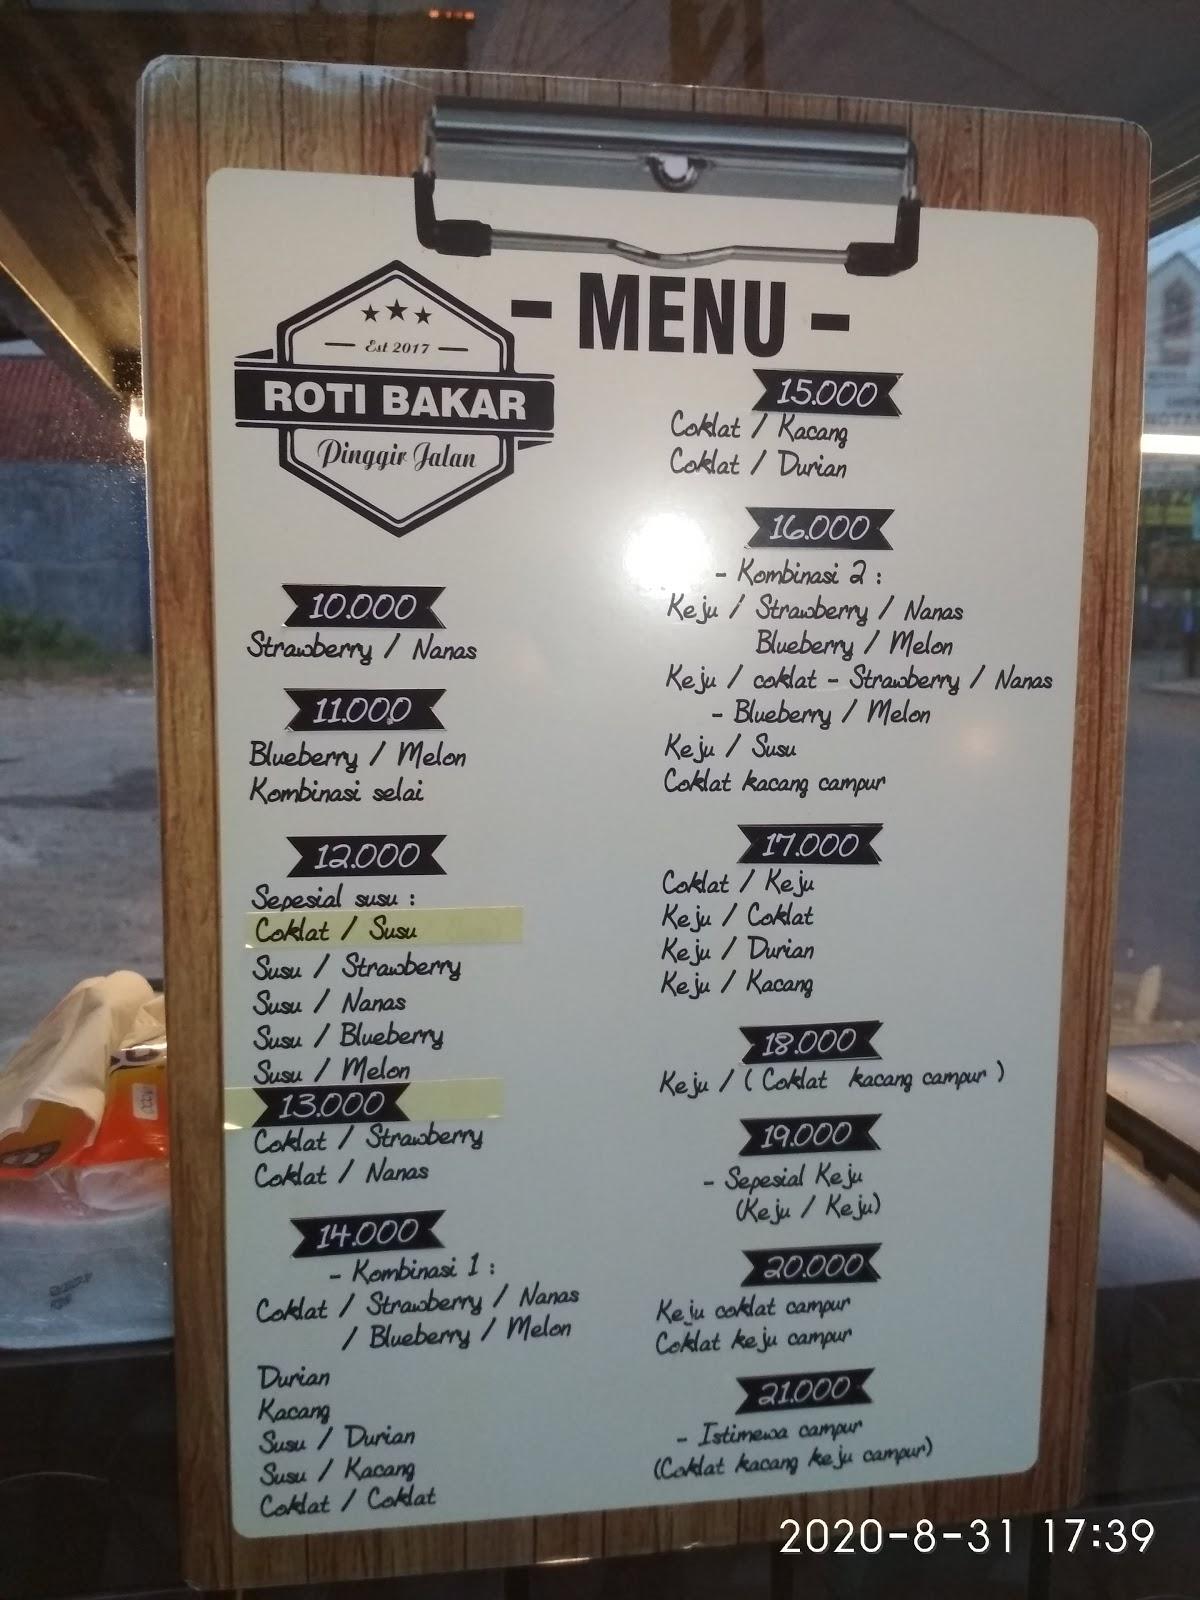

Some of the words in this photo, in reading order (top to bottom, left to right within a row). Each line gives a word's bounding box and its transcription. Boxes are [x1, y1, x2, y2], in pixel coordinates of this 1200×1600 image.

[579, 272, 786, 357] MENU
[365, 339, 388, 353] Est
[392, 342, 431, 354] 2017
[264, 380, 367, 416] ROTI
[383, 384, 527, 421] BAKAR
[777, 378, 878, 407] 15.000
[671, 410, 740, 438] Coklat
[751, 413, 768, 439] /
[778, 412, 848, 449] Kacang
[317, 438, 408, 471] Pinggir
[413, 441, 477, 472] Jalan
[670, 447, 739, 475] Coklat
[750, 449, 767, 475] /
[778, 449, 847, 479] Durian
[769, 514, 870, 541] 16.000
[738, 558, 839, 586] Kombinasi
[850, 560, 866, 584] 2
[309, 592, 417, 620] 10.000
[667, 593, 718, 624] Keju
[729, 594, 745, 619] /
[756, 593, 868, 627] Strawberry
[878, 595, 894, 620] /
[904, 595, 963, 621] Nanas
[247, 630, 372, 666] Strawberry
[384, 633, 401, 659] /
[412, 633, 477, 660] Nanas
[756, 629, 854, 661] Blueberry
[864, 630, 880, 655] /
[890, 630, 953, 657] Melon
[666, 664, 717, 694] Keju
[727, 664, 743, 689] /
[753, 664, 817, 689] coklat
[849, 664, 960, 696] Strawberry
[970, 665, 985, 689] /
[995, 664, 1053, 690] Nanas
[734, 698, 831, 730] Blueberry
[841, 699, 858, 723] /
[867, 698, 930, 726] Melon
[249, 741, 358, 773] Blueberry
[369, 741, 386, 766] /
[397, 741, 466, 769] Melon
[665, 733, 715, 763] Keju
[725, 733, 741, 758] /
[752, 733, 796, 758] Susu
[250, 776, 361, 804] Kombinasi
[372, 776, 424, 801] selai
[664, 767, 731, 792] Coklat
[742, 769, 808, 798] kacang
[819, 775, 886, 798] campur
[314, 843, 421, 870] 12.000
[762, 832, 860, 858] 17.000
[251, 882, 343, 912] Sepesial
[355, 892, 398, 907] susu
[663, 869, 729, 894] Coklat
[739, 869, 755, 893] /
[765, 868, 814, 897] Keju
[256, 916, 329, 942] Coklat
[341, 915, 358, 941] /
[369, 915, 417, 940] Susu
[662, 903, 712, 933] Keju
[722, 903, 738, 927] /
[748, 902, 814, 926] Coklat
[661, 937, 711, 966] Keju
[721, 936, 737, 960] /
[747, 935, 814, 960] Durian
[252, 954, 302, 981] Susu
[313, 953, 330, 978] /
[342, 951, 461, 981] Strawberry
[661, 971, 711, 999] Keju
[721, 969, 736, 993] /
[746, 968, 813, 998] Kacang
[253, 990, 302, 1015] Susu
[313, 988, 330, 1014] /
[342, 987, 407, 1014] Nanas
[253, 1025, 302, 1050] Susu
[314, 1023, 331, 1048] /
[340, 1021, 443, 1050] Blueberry
[762, 1028, 857, 1056] 18.000
[253, 1060, 303, 1084] Susu
[314, 1057, 331, 1082] /
[341, 1056, 410, 1081] Melon
[660, 1070, 709, 1099] Keju
[719, 1069, 735, 1093] /
[745, 1068, 752, 1092] (
[763, 1066, 827, 1091] Coklat
[848, 1066, 912, 1093] kacang
[922, 1070, 986, 1090] campur
[997, 1060, 1004, 1082] )
[278, 1091, 385, 1119] 13.000
[254, 1127, 327, 1154] Coklat
[338, 1125, 355, 1150] /
[366, 1121, 483, 1150] Strawberry
[761, 1121, 853, 1148] 19.000
[255, 1161, 327, 1188] Coklat
[338, 1159, 355, 1184] /
[366, 1156, 429, 1183] Nanas
[725, 1163, 805, 1195] Sepesial
[815, 1162, 863, 1190] Keju
[736, 1197, 791, 1225] (Keju
[801, 1195, 816, 1218] /
[826, 1192, 880, 1221] Keju)
[316, 1219, 419, 1250] 14.000
[352, 1257, 457, 1285] Kombinasi
[468, 1252, 479, 1277] 1
[763, 1253, 865, 1279] 20.000
[256, 1296, 328, 1323] Coklat
[339, 1293, 355, 1318] /
[366, 1288, 482, 1316] Strawberry
[493, 1283, 509, 1308] /
[519, 1281, 579, 1307] Nanas
[656, 1299, 704, 1326] Keju
[715, 1294, 776, 1319] coklat
[786, 1297, 851, 1319] campur
[341, 1326, 358, 1351] /
[369, 1322, 470, 1349] Blueberry
[481, 1317, 496, 1341] /
[507, 1314, 571, 1341] Melon
[656, 1329, 720, 1355] Coklat
[731, 1326, 777, 1353] keju
[788, 1328, 852, 1350] campur
[257, 1365, 330, 1390] Durian
[758, 1376, 851, 1406] 21.000
[258, 1398, 331, 1424] Kacang
[259, 1430, 307, 1454] Susu
[317, 1426, 333, 1450] /
[344, 1425, 415, 1448] Durian
[698, 1422, 789, 1447] Istimewa
[799, 1419, 863, 1441] campur
[260, 1462, 307, 1486] Susu
[317, 1458, 334, 1482] /
[344, 1456, 416, 1482] Kacang
[654, 1454, 724, 1480] (Coklat
[735, 1452, 798, 1475] kacang
[808, 1445, 853, 1470] keju
[863, 1436, 933, 1466] campur)
[260, 1492, 330, 1518] Coklat
[341, 1488, 357, 1512] /
[368, 1484, 436, 1510] Coklat
